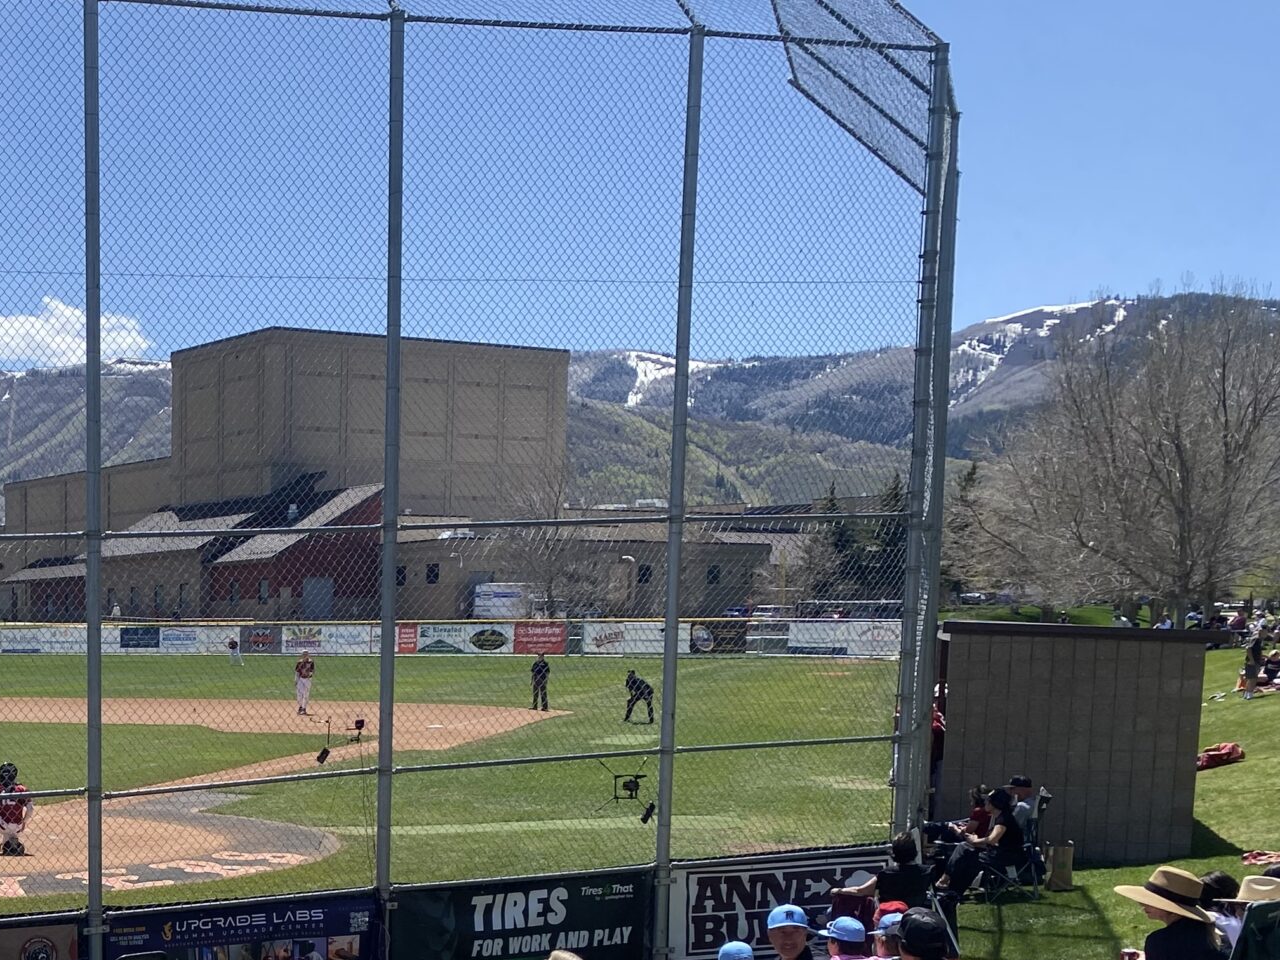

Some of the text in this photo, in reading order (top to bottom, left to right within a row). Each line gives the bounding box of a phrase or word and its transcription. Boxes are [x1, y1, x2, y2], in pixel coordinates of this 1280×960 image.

[176, 909, 324, 931] UPGRADE LABS
[471, 887, 568, 932] TIRES
[175, 923, 325, 940] HUMAN UPGRADE CENTER
[471, 926, 633, 957] FOR WORK AND PLAY
